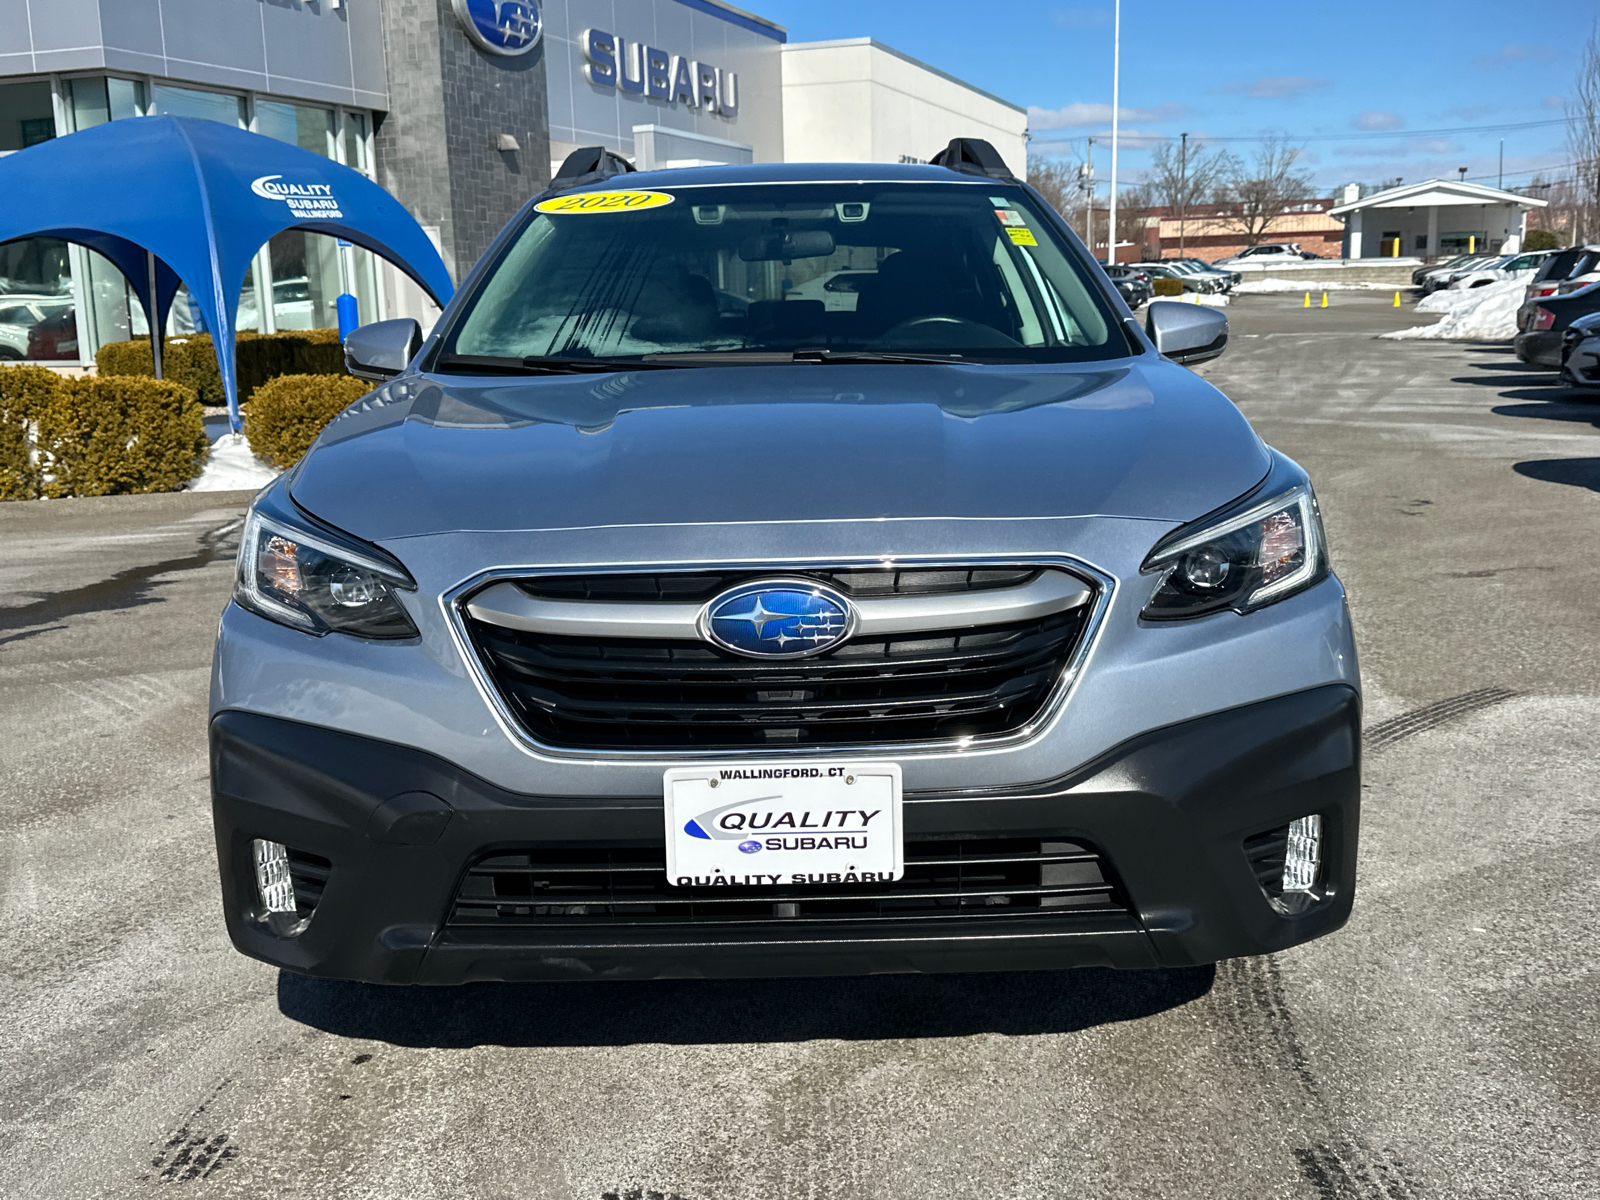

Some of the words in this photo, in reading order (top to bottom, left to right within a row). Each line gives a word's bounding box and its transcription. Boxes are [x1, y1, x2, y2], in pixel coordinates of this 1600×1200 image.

[582, 28, 739, 118] SUBARU
[264, 182, 331, 195] QUALITY
[286, 199, 339, 209] SUBARU
[554, 194, 652, 211] 2020
[290, 209, 343, 218] WALLINGFORD
[719, 767, 824, 780] WALLINGFORD,
[828, 767, 846, 777] CT
[719, 809, 882, 830] QUALITY
[765, 836, 868, 851] SUBARU
[676, 874, 782, 887] QUALITY
[791, 871, 894, 884] SUBARU
